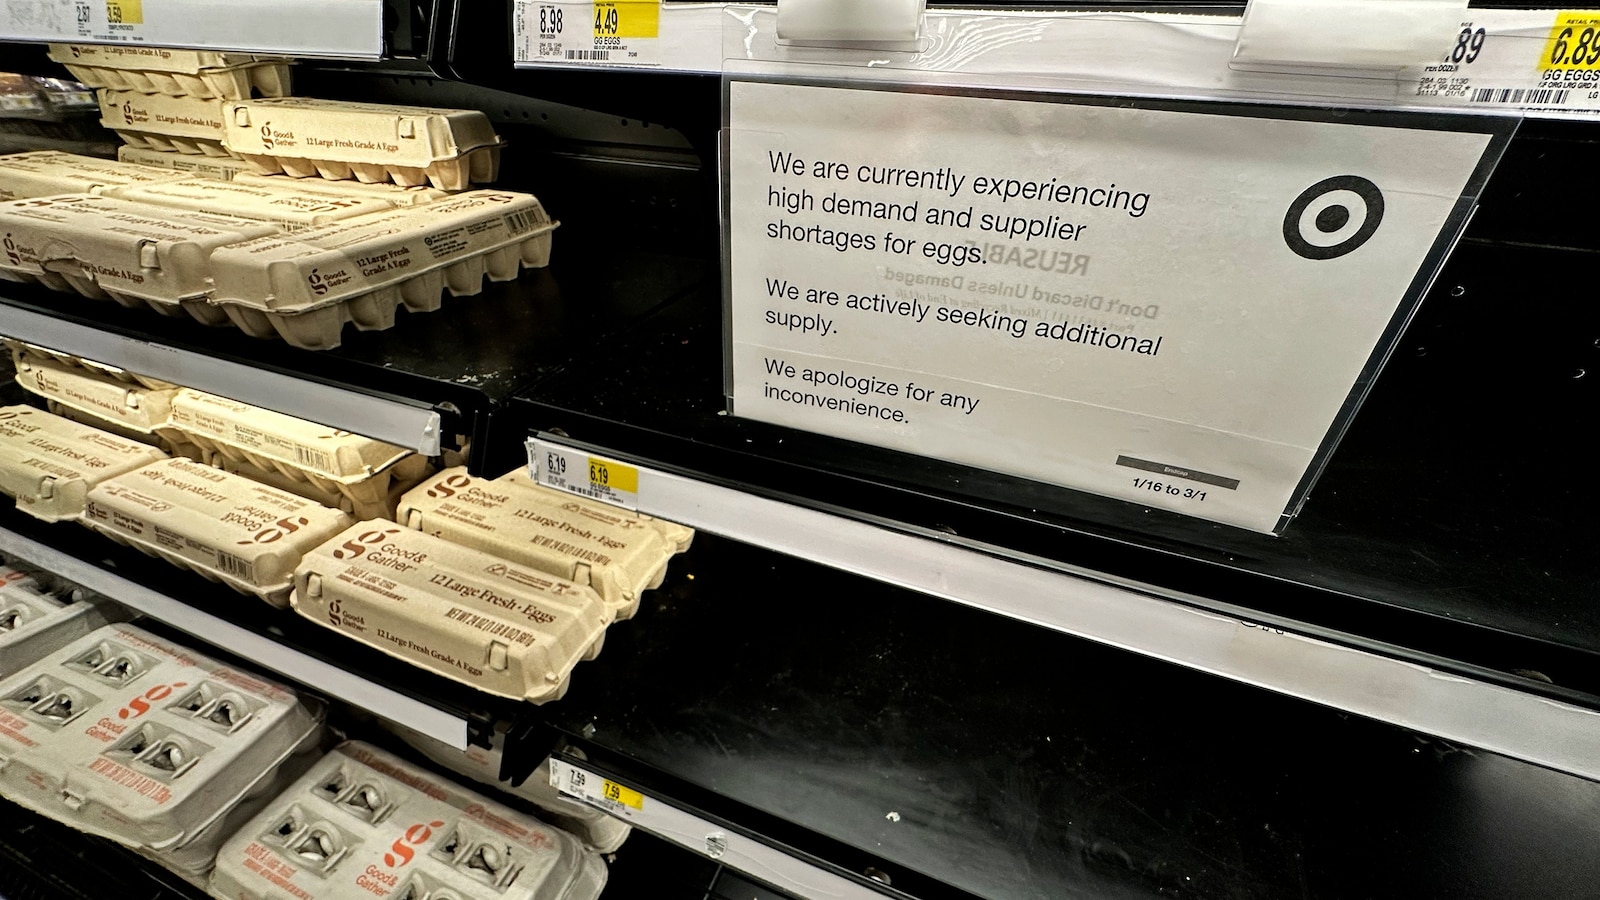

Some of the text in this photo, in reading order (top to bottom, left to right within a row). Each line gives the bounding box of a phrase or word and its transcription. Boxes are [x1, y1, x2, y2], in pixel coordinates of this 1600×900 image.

[76, 5, 122, 23] 2.87 3.59
[540, 8, 563, 33] 8.98
[595, 8, 618, 34] 4.49
[594, 36, 621, 45] GG EGGS
[1542, 69, 1600, 81] GG EGGS
[306, 137, 399, 152] 12 Large Fresh Grade A Eggs
[769, 150, 1151, 218] We are currently experiencing
[768, 185, 1087, 241] high demand and supplier
[767, 219, 987, 267] shortages for eggs.
[356, 246, 410, 268] 12 Large Fresh
[362, 265, 387, 277] Grade
[393, 258, 411, 269] Eggs
[98, 265, 145, 284] Grade A Eggs
[765, 310, 838, 337] supply.
[766, 277, 1163, 356] We are actively seeking additional
[764, 357, 980, 415] We apologize for any
[765, 382, 909, 424] inconvenience.
[548, 454, 609, 484] 6.19 6.19
[1132, 478, 1207, 502] 1/16 to 3/1
[513, 509, 627, 549] 12 Large Fresh Eggs
[367, 551, 413, 572] Gather
[381, 543, 427, 563] Good&
[429, 573, 557, 624] 12 Large Fresh Eggs
[377, 629, 483, 676] 12 Large Fresh Grade A Eggs
[570, 769, 620, 799] 7.59 7.59
[356, 875, 390, 898] Gather
[366, 864, 398, 888] Good&
